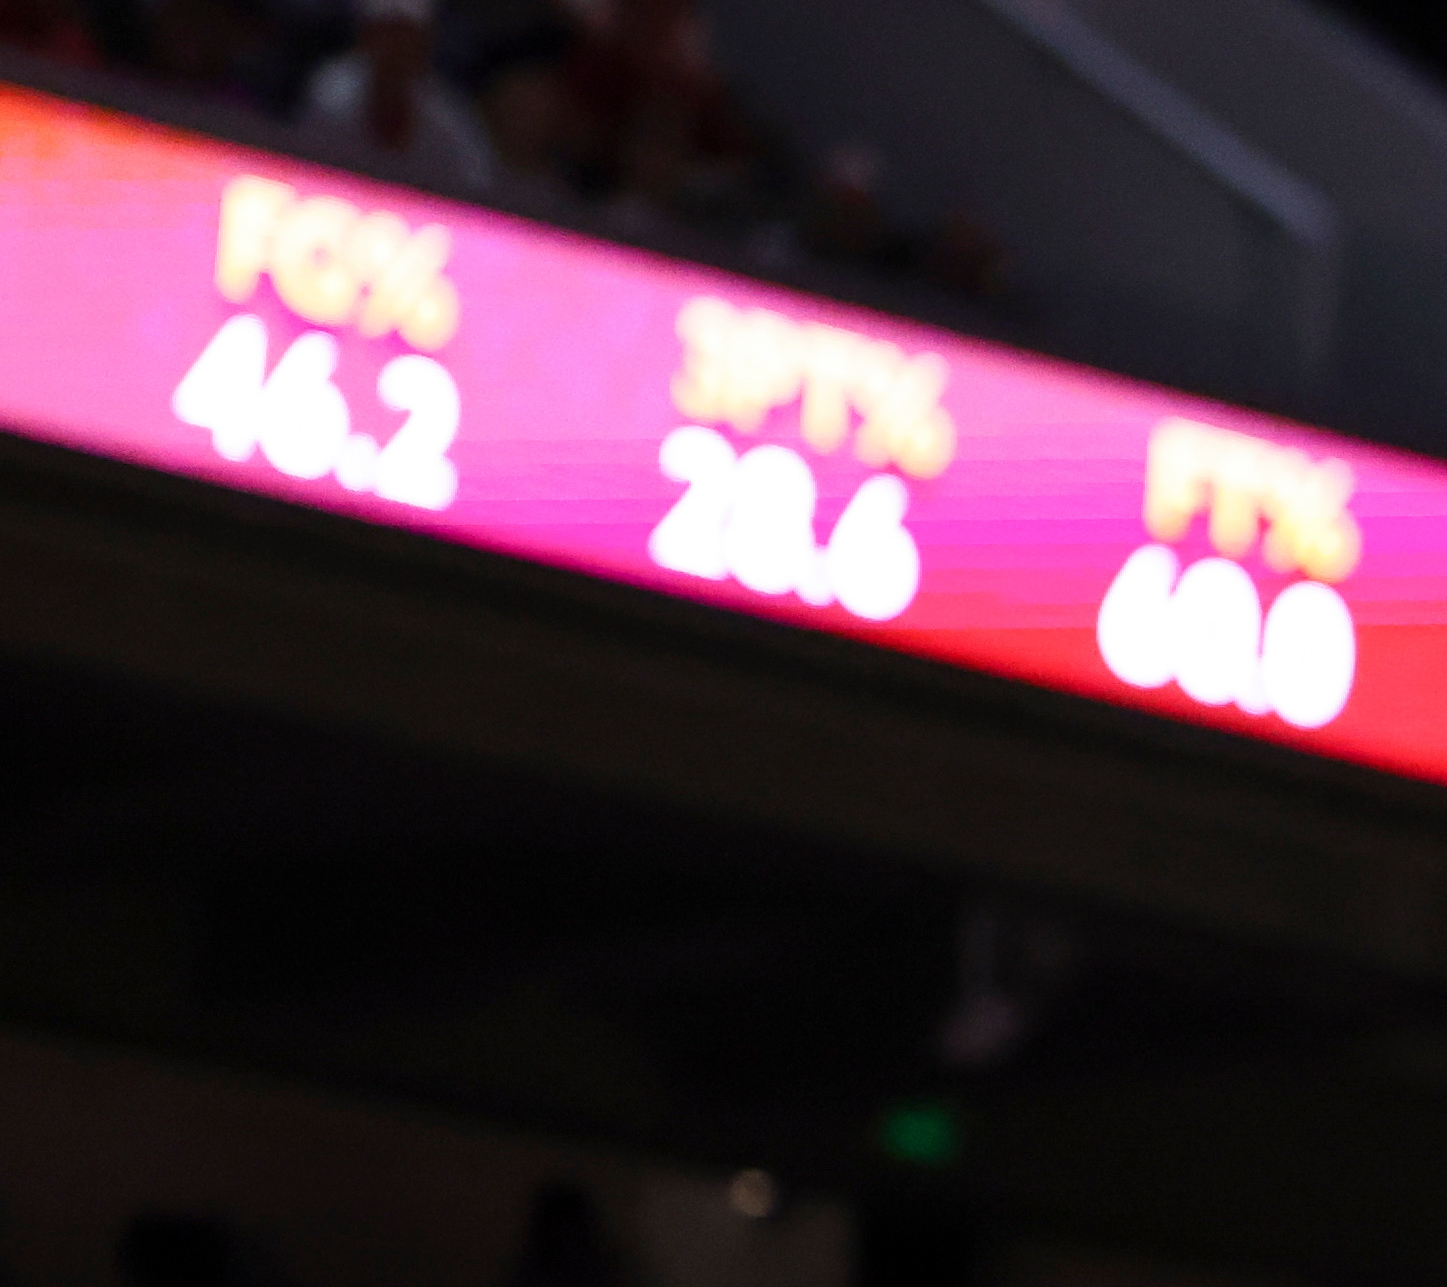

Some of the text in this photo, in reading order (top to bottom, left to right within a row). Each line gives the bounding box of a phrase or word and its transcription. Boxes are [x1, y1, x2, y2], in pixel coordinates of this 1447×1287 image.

[216, 174, 460, 351] FG%
[172, 314, 460, 510] 46.2
[1146, 417, 1360, 582] FT%
[1098, 543, 1355, 728] 60.0
